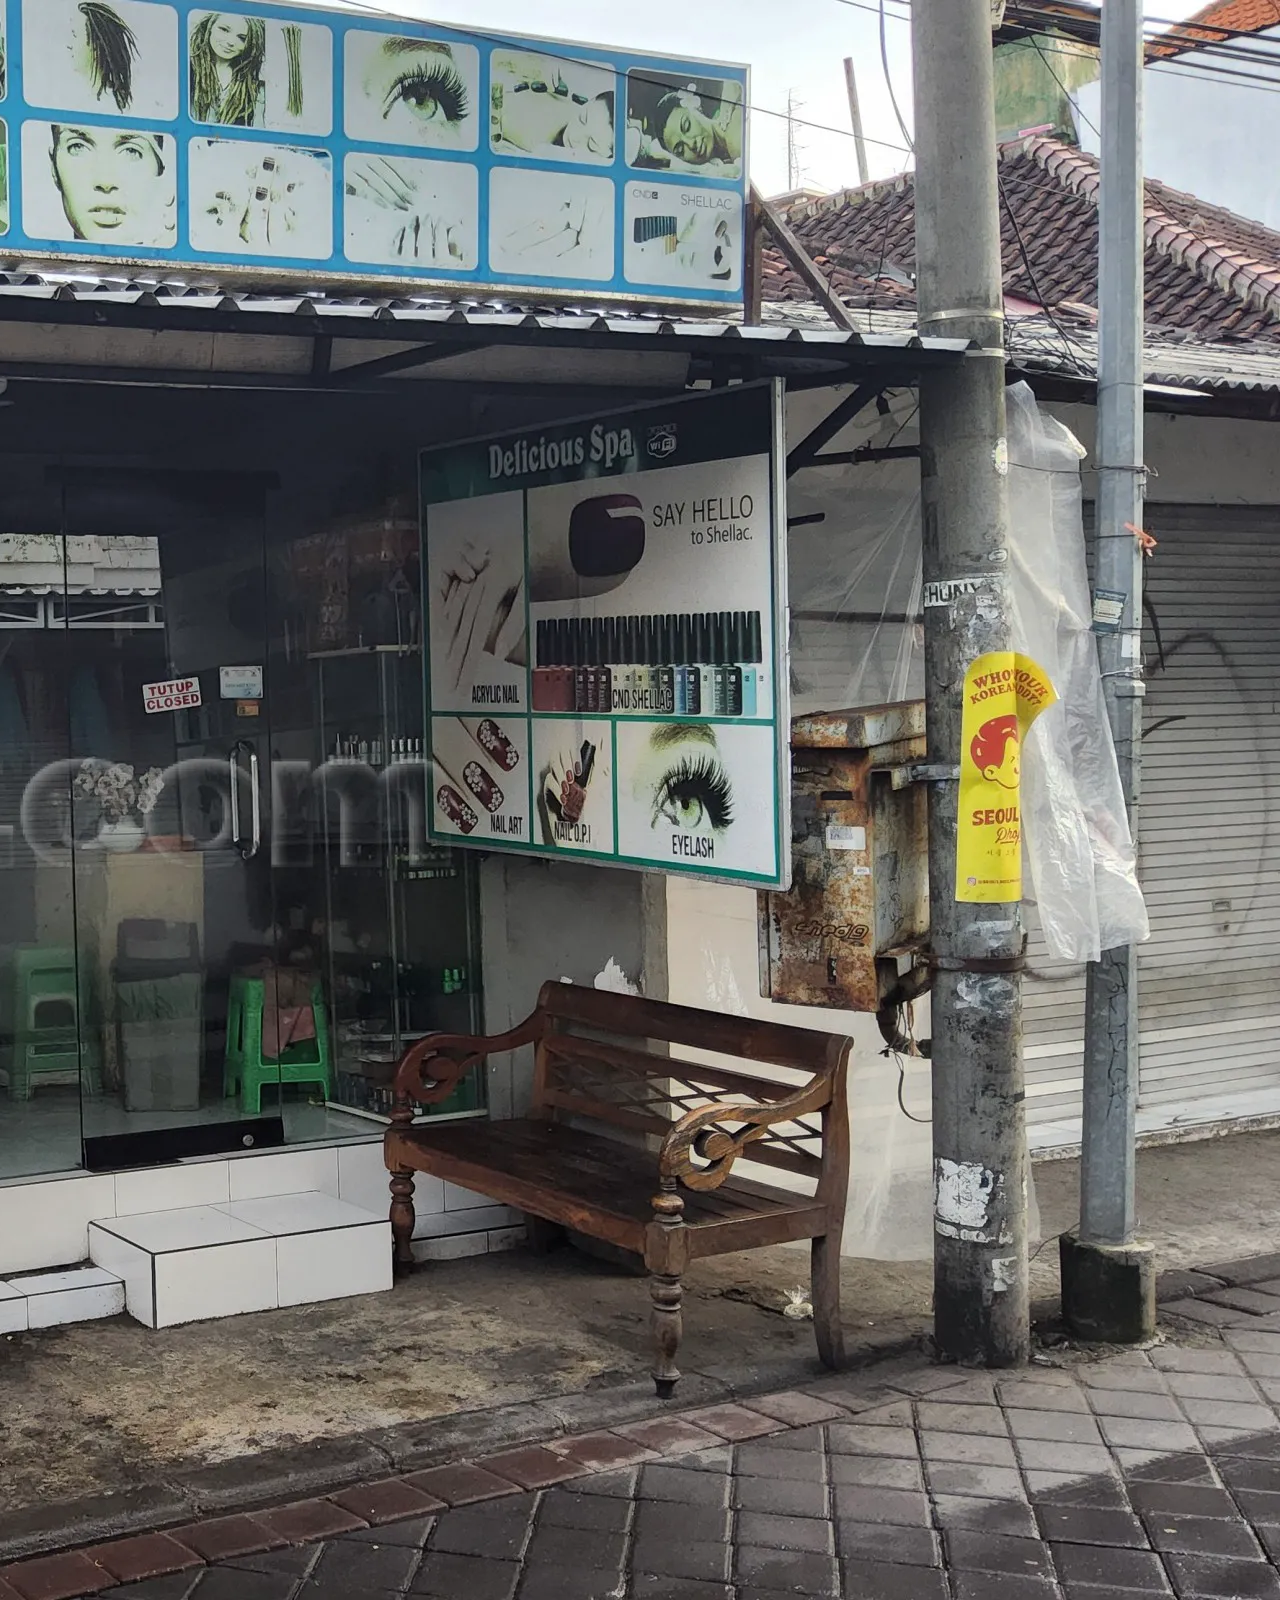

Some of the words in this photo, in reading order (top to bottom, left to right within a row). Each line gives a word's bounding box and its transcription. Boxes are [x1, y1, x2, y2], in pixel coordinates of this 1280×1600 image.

[681, 193, 733, 211] SHELLAC
[489, 431, 584, 478] Delicious
[590, 424, 634, 469] Spa
[652, 502, 685, 527] SAY
[692, 494, 754, 524] HELLO
[691, 527, 703, 545] to
[706, 524, 753, 544] Shellac.
[148, 681, 194, 696] TUTUP
[471, 685, 502, 704] ACRYLIC
[503, 684, 520, 704] NAIL
[146, 694, 199, 711] CLOSED
[612, 688, 631, 710] CND
[632, 688, 673, 711] SHELLAC
[491, 814, 508, 834] NAIL
[509, 815, 523, 835] ART
[972, 806, 1019, 826] SEOUL
[554, 821, 572, 841] NAIL
[672, 834, 715, 859] EYELASH
